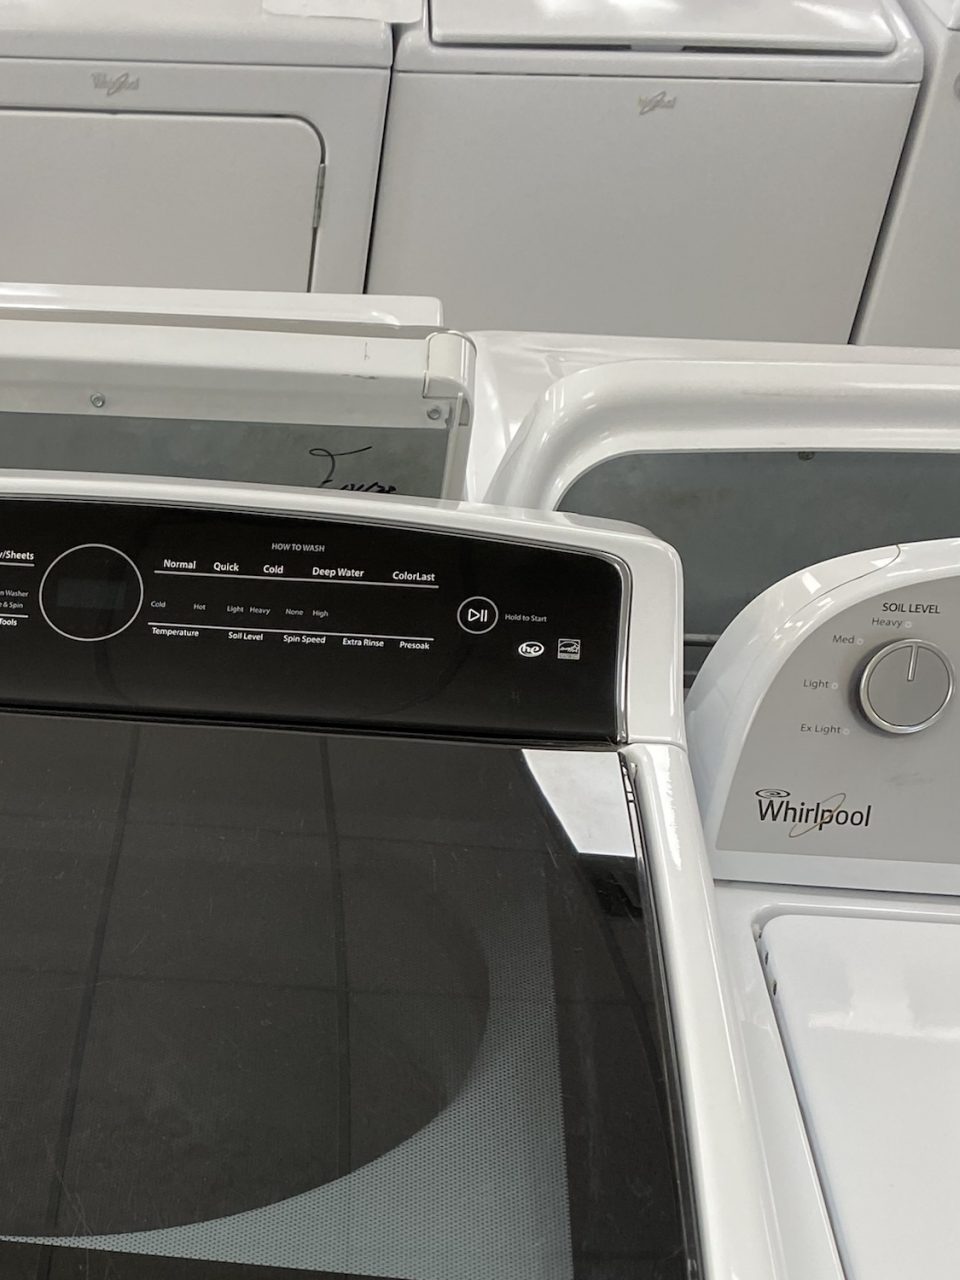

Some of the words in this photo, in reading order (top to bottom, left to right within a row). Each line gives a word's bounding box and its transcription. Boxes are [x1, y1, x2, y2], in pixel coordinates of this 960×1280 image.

[271, 542, 292, 551] HOW
[292, 543, 302, 552] TO
[302, 543, 325, 553] WASH
[163, 559, 196, 570] Normal
[213, 561, 239, 572] Quick
[263, 564, 284, 575] Cold
[312, 567, 336, 578] Deep
[337, 568, 365, 578] Water
[392, 570, 436, 582] ColorLast
[5, 589, 29, 598] Washer
[9, 601, 24, 610] Spin
[150, 600, 166, 609] Cold
[193, 603, 206, 611] Hot
[226, 605, 244, 614] Light
[882, 602, 906, 613] SOIL
[908, 603, 940, 614] LEVEL
[249, 606, 271, 616] Heavy
[285, 608, 304, 616] None
[312, 609, 329, 618] High
[504, 613, 522, 621] Hold
[530, 614, 547, 623] Start
[871, 617, 903, 629] Heavy
[151, 627, 200, 637] Temperature
[228, 631, 243, 640] Soil
[243, 633, 264, 641] Level
[283, 634, 300, 644] Spin
[301, 635, 326, 645] Speed
[342, 637, 362, 646] Extra
[363, 638, 385, 648] Rinse
[832, 634, 855, 644] Med
[399, 640, 430, 650] Presoak
[803, 679, 829, 690] Light
[800, 723, 813, 733] Ex
[814, 724, 841, 736] Light
[758, 798, 871, 831] Whirlpool
